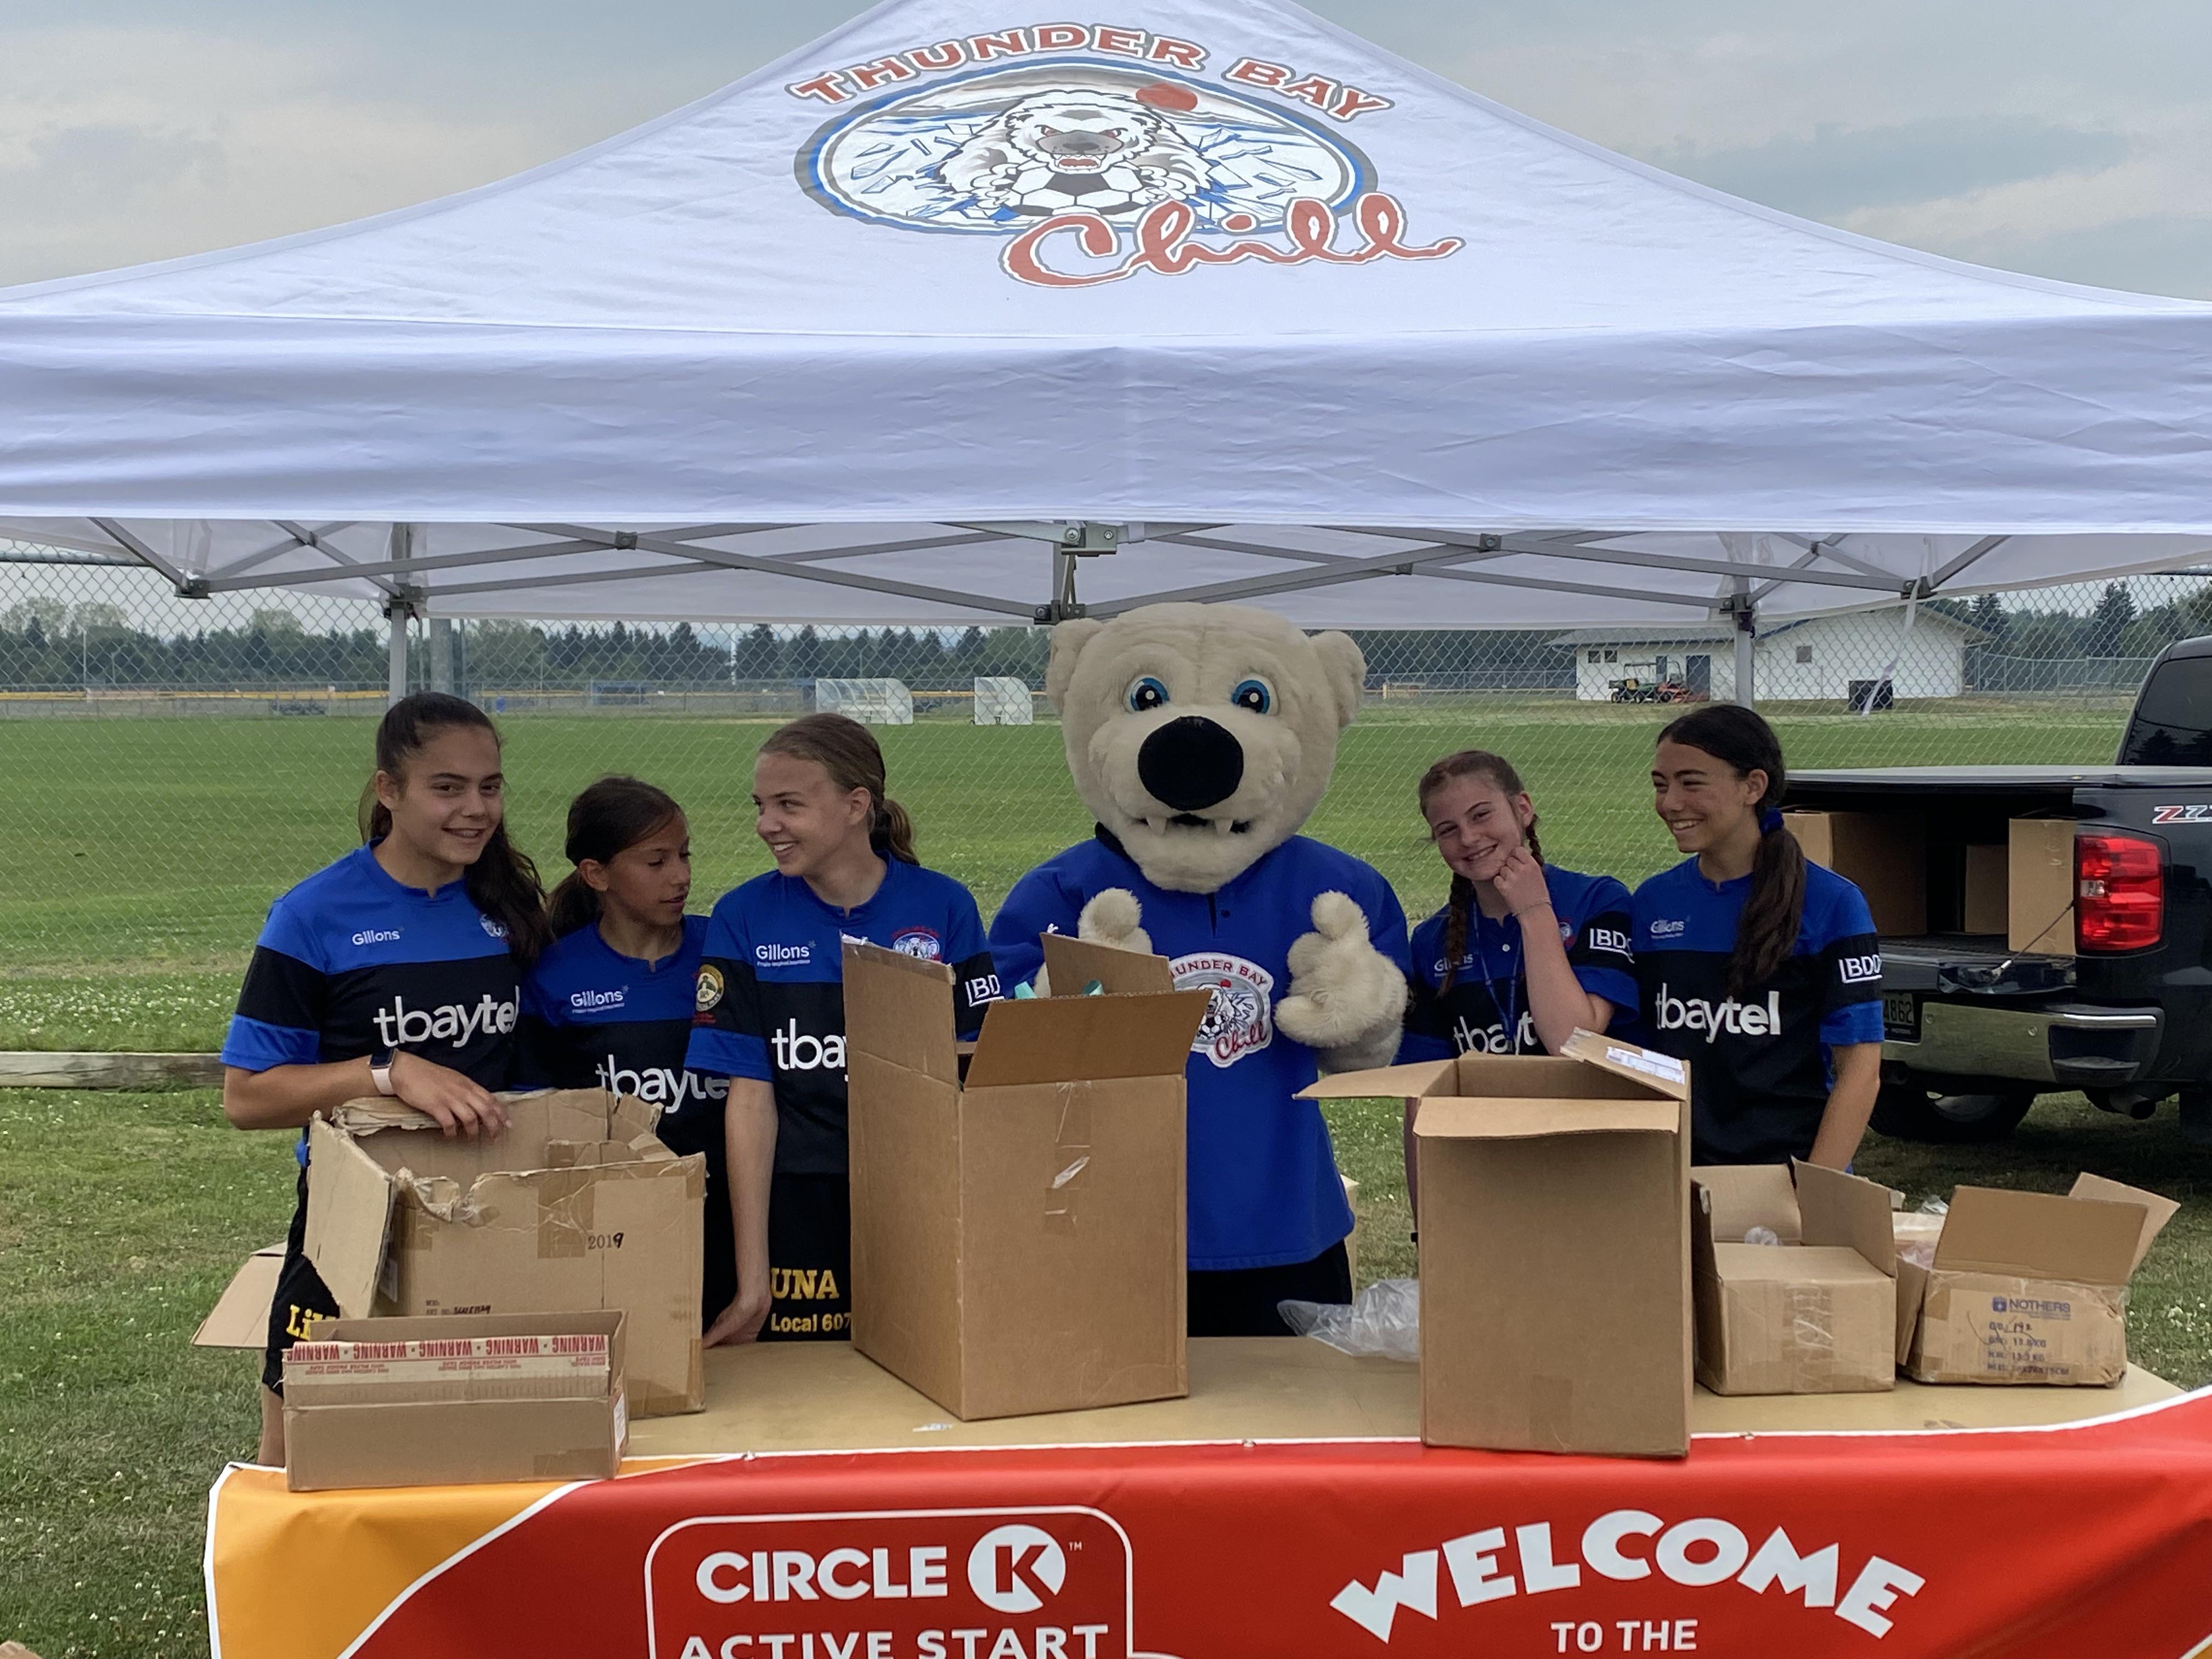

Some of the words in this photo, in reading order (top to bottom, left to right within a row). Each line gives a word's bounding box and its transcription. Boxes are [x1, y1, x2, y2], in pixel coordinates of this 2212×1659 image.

[789, 25, 1205, 104] THUNDER
[1224, 59, 1393, 121] BAY
[1000, 193, 1465, 287] Chill
[2152, 804, 2212, 824] Z7
[352, 929, 400, 945] Gillons
[756, 944, 809, 960] Gillons
[1170, 960, 1232, 978] UNDER
[1239, 966, 1266, 985] BAY
[571, 990, 623, 1006] Gillons
[373, 985, 520, 1048] tbaytel
[1655, 983, 1781, 1043] tbaytel
[1216, 1020, 1267, 1059] Chill
[588, 1232, 624, 1249] 2019
[771, 1313, 817, 1332] Local
[822, 1312, 850, 1332] 607
[287, 1344, 340, 1362] WARNING
[353, 1342, 407, 1359] WARNING
[419, 1340, 472, 1358] WARNING
[486, 1338, 539, 1355] WARNING
[552, 1335, 605, 1353] WARNING
[696, 1544, 948, 1604] CIRCLE
[1329, 1509, 1926, 1644] WELCOME
[679, 1630, 893, 1659] ACTIVE
[917, 1624, 1109, 1659] START
[1550, 1622, 1602, 1653] TO
[1616, 1620, 1698, 1651] THE
